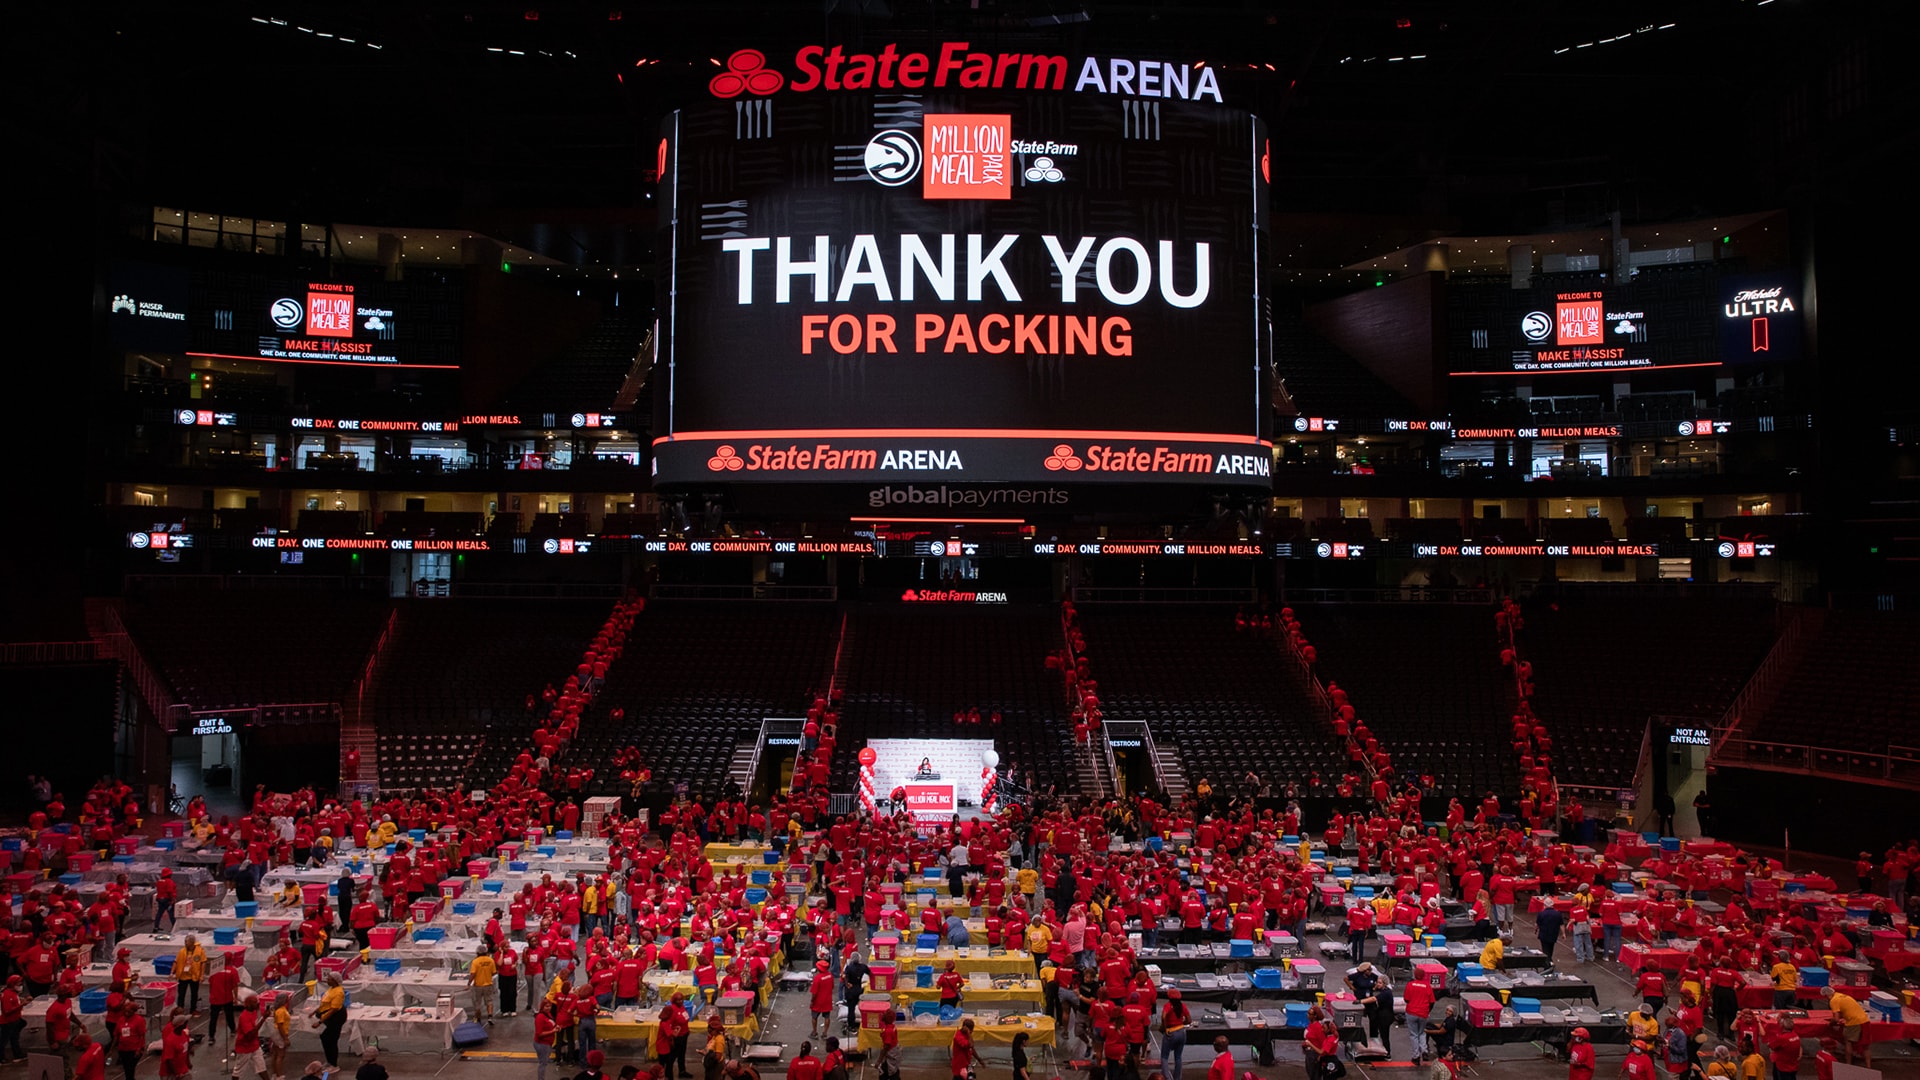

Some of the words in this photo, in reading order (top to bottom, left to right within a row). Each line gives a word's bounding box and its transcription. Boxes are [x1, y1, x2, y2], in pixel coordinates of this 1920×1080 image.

[1074, 57, 1223, 103] ARENA
[931, 125, 1004, 155] MILLION
[931, 154, 981, 186] MEAL
[981, 155, 1003, 186] PACK
[722, 233, 1023, 305] THANK
[1040, 234, 1211, 309] YOU
[308, 283, 343, 292] WELCOME
[1557, 292, 1591, 300] WELCOME
[1592, 291, 1603, 299] TO
[139, 302, 163, 311] KAISER
[311, 298, 350, 314] MILLION
[1725, 298, 1795, 318] ULTRA
[139, 310, 185, 321] PERMANENTE
[1560, 307, 1599, 323] MILLION
[311, 314, 338, 329] MEAL
[800, 313, 898, 355] FOR
[914, 313, 1134, 357] PACKING
[1560, 322, 1587, 338] MEAL
[285, 340, 319, 351] MAKE
[332, 342, 373, 353] ASSIST
[1537, 351, 1570, 361] MAKE
[1584, 348, 1624, 360] ASSIST
[291, 418, 314, 428] ONE
[315, 419, 336, 429] DAY.
[337, 420, 360, 430] ONE
[360, 420, 420, 431] COMMUNITY.
[421, 422, 442, 431] ONE
[489, 415, 522, 425] MEALS.
[1389, 420, 1408, 430] ONE
[1410, 421, 1428, 430] DAY.
[1458, 428, 1517, 438] COMMUNITY.
[1518, 428, 1539, 438] ONE
[1540, 427, 1580, 437] MILLION
[1583, 426, 1620, 436] MEALS.
[880, 449, 963, 471] ARENA
[1215, 454, 1271, 478] ARENA
[252, 538, 275, 548] ONE
[277, 538, 299, 548] DAY.
[302, 538, 325, 549] ONE
[326, 539, 389, 549] COMMUNITY.
[391, 540, 413, 550] ONE
[414, 540, 454, 550] MILLION
[455, 540, 490, 550] MEALS.
[645, 542, 667, 551] ONE
[668, 542, 688, 552] DAY.
[690, 542, 711, 552] ONE
[712, 542, 773, 552] COMMUNITY.
[774, 542, 796, 552] ONE
[797, 542, 838, 552] MILLION
[839, 543, 876, 553] MEALS.
[1034, 544, 1055, 554] ONE
[1057, 544, 1077, 554] DAY.
[1079, 544, 1101, 554] ONE
[1102, 545, 1162, 555] COMMUNITY.
[1164, 545, 1185, 555] ONE
[1187, 545, 1227, 555] MILLION
[1229, 545, 1264, 555] MEALS.
[1417, 545, 1438, 555] ONE
[1440, 545, 1459, 555] DAY.
[1461, 545, 1482, 555] ONE
[1484, 545, 1545, 555] COMMUNITY.
[1547, 545, 1569, 555] ONE
[1571, 545, 1614, 555] MILLION
[1617, 545, 1655, 555] MEALS.
[976, 592, 1007, 602] ARENA
[199, 718, 218, 727] EMT
[218, 717, 225, 726] &
[192, 725, 232, 735] FIRST-AID
[1676, 728, 1693, 736] NOT
[1694, 729, 1707, 737] AN
